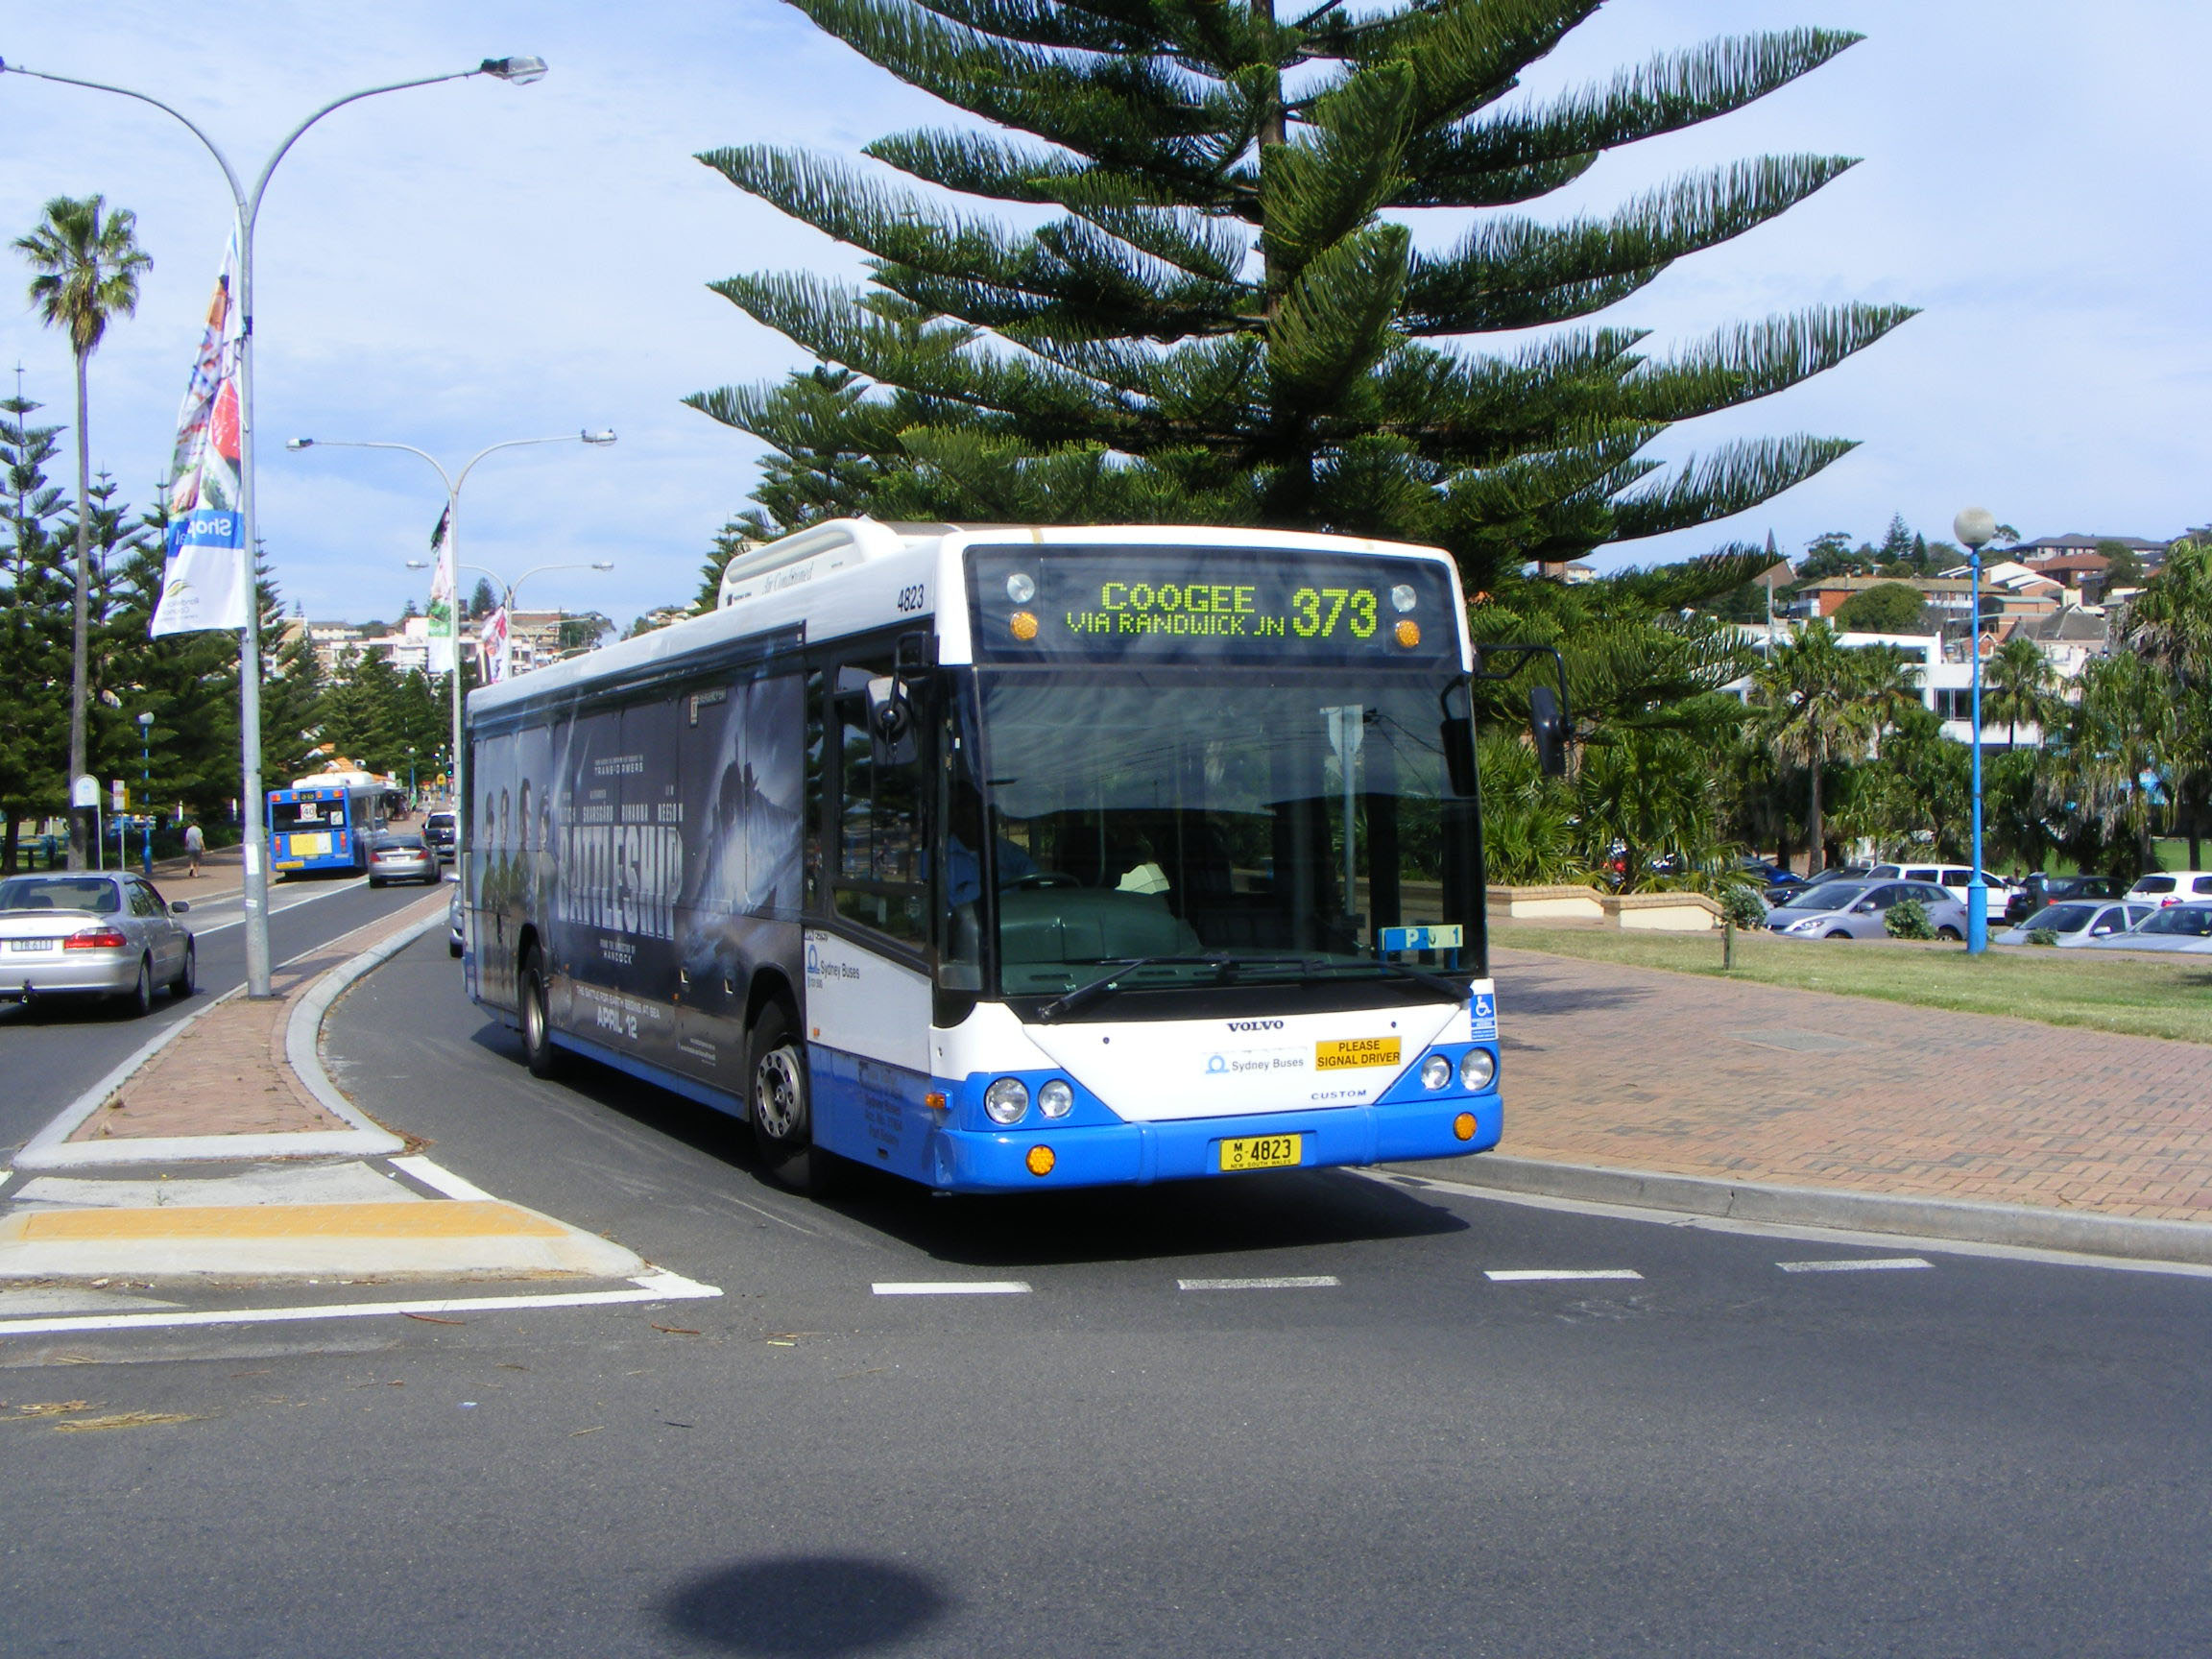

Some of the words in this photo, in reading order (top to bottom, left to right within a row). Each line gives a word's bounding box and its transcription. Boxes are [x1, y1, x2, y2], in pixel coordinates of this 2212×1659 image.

[897, 584, 925, 613] 4823
[1101, 582, 1256, 613] COOGEE
[1292, 588, 1378, 637] 373
[1067, 612, 1111, 634] VIA
[1118, 613, 1246, 636] RANDWICK
[1253, 615, 1286, 637] JN
[842, 962, 860, 979] Buses
[597, 1005, 623, 1034] APRIL
[626, 1014, 637, 1039] 12
[1227, 1020, 1285, 1032] VOLVO
[1338, 1040, 1381, 1052] PLEASE
[1232, 1060, 1269, 1072] Sydney
[1273, 1058, 1304, 1068] Buses
[1317, 1054, 1358, 1068] SIGNAL
[1360, 1051, 1400, 1065] DRIVER
[1311, 1089, 1367, 1100] CUSTOM
[1250, 1139, 1291, 1161] 4823
